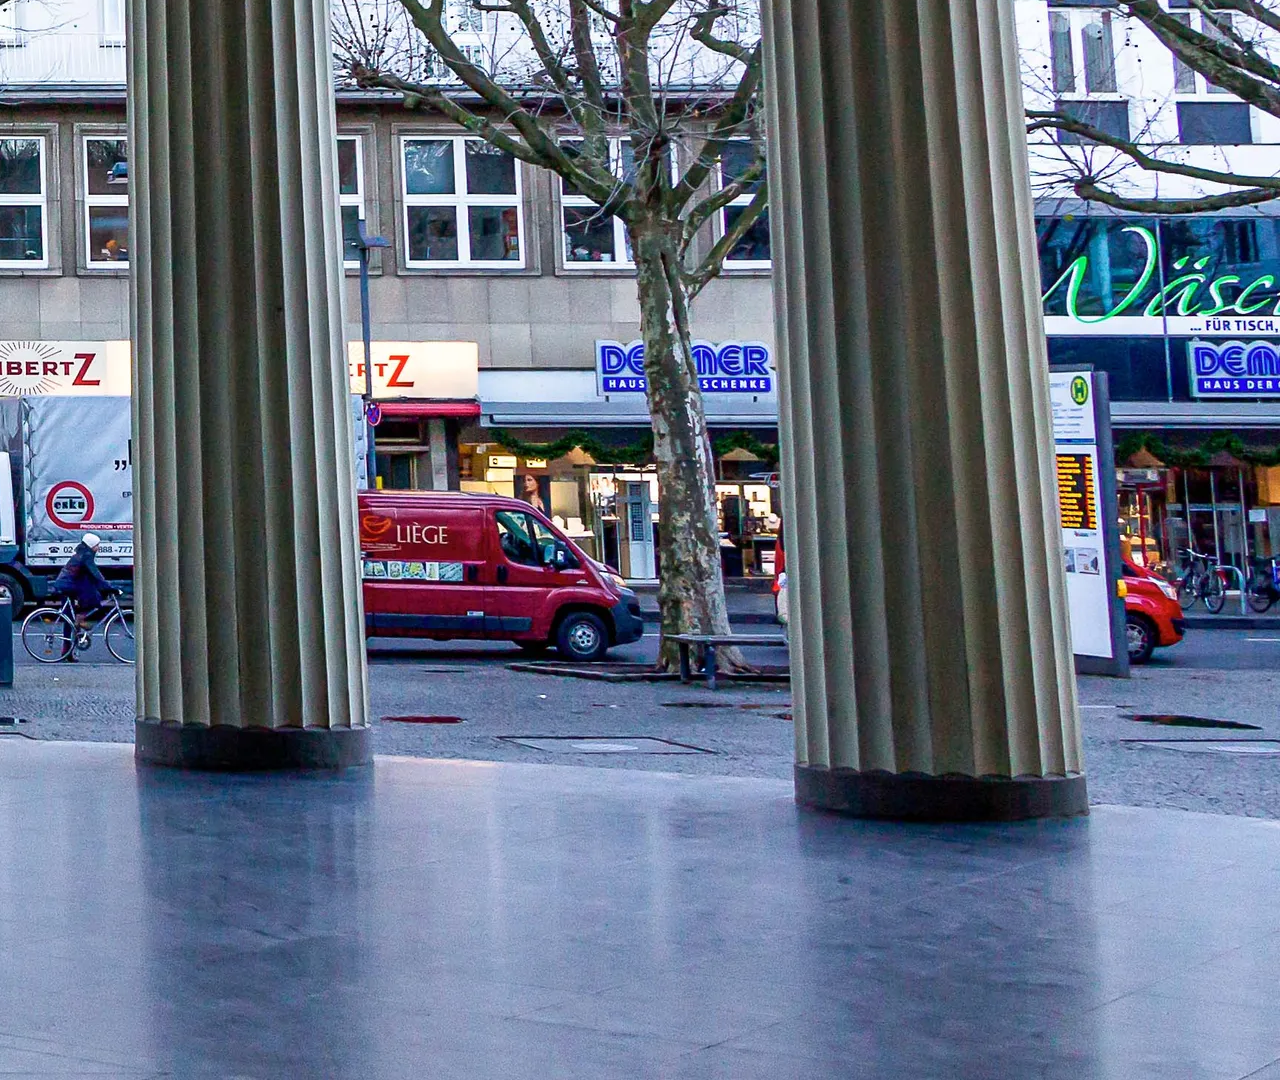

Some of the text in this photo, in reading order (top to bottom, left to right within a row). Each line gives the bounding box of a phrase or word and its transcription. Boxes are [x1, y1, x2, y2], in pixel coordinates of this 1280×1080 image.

[1042, 227, 1280, 323] Wäsc
[1206, 319, 1231, 331] FÜR
[1237, 320, 1278, 333] TISCH,
[349, 355, 414, 387] RTZ
[609, 379, 645, 389] HAUS
[1203, 380, 1272, 390] HAUS DER
[54, 498, 85, 509] esku
[397, 522, 448, 544] LIÈGE
